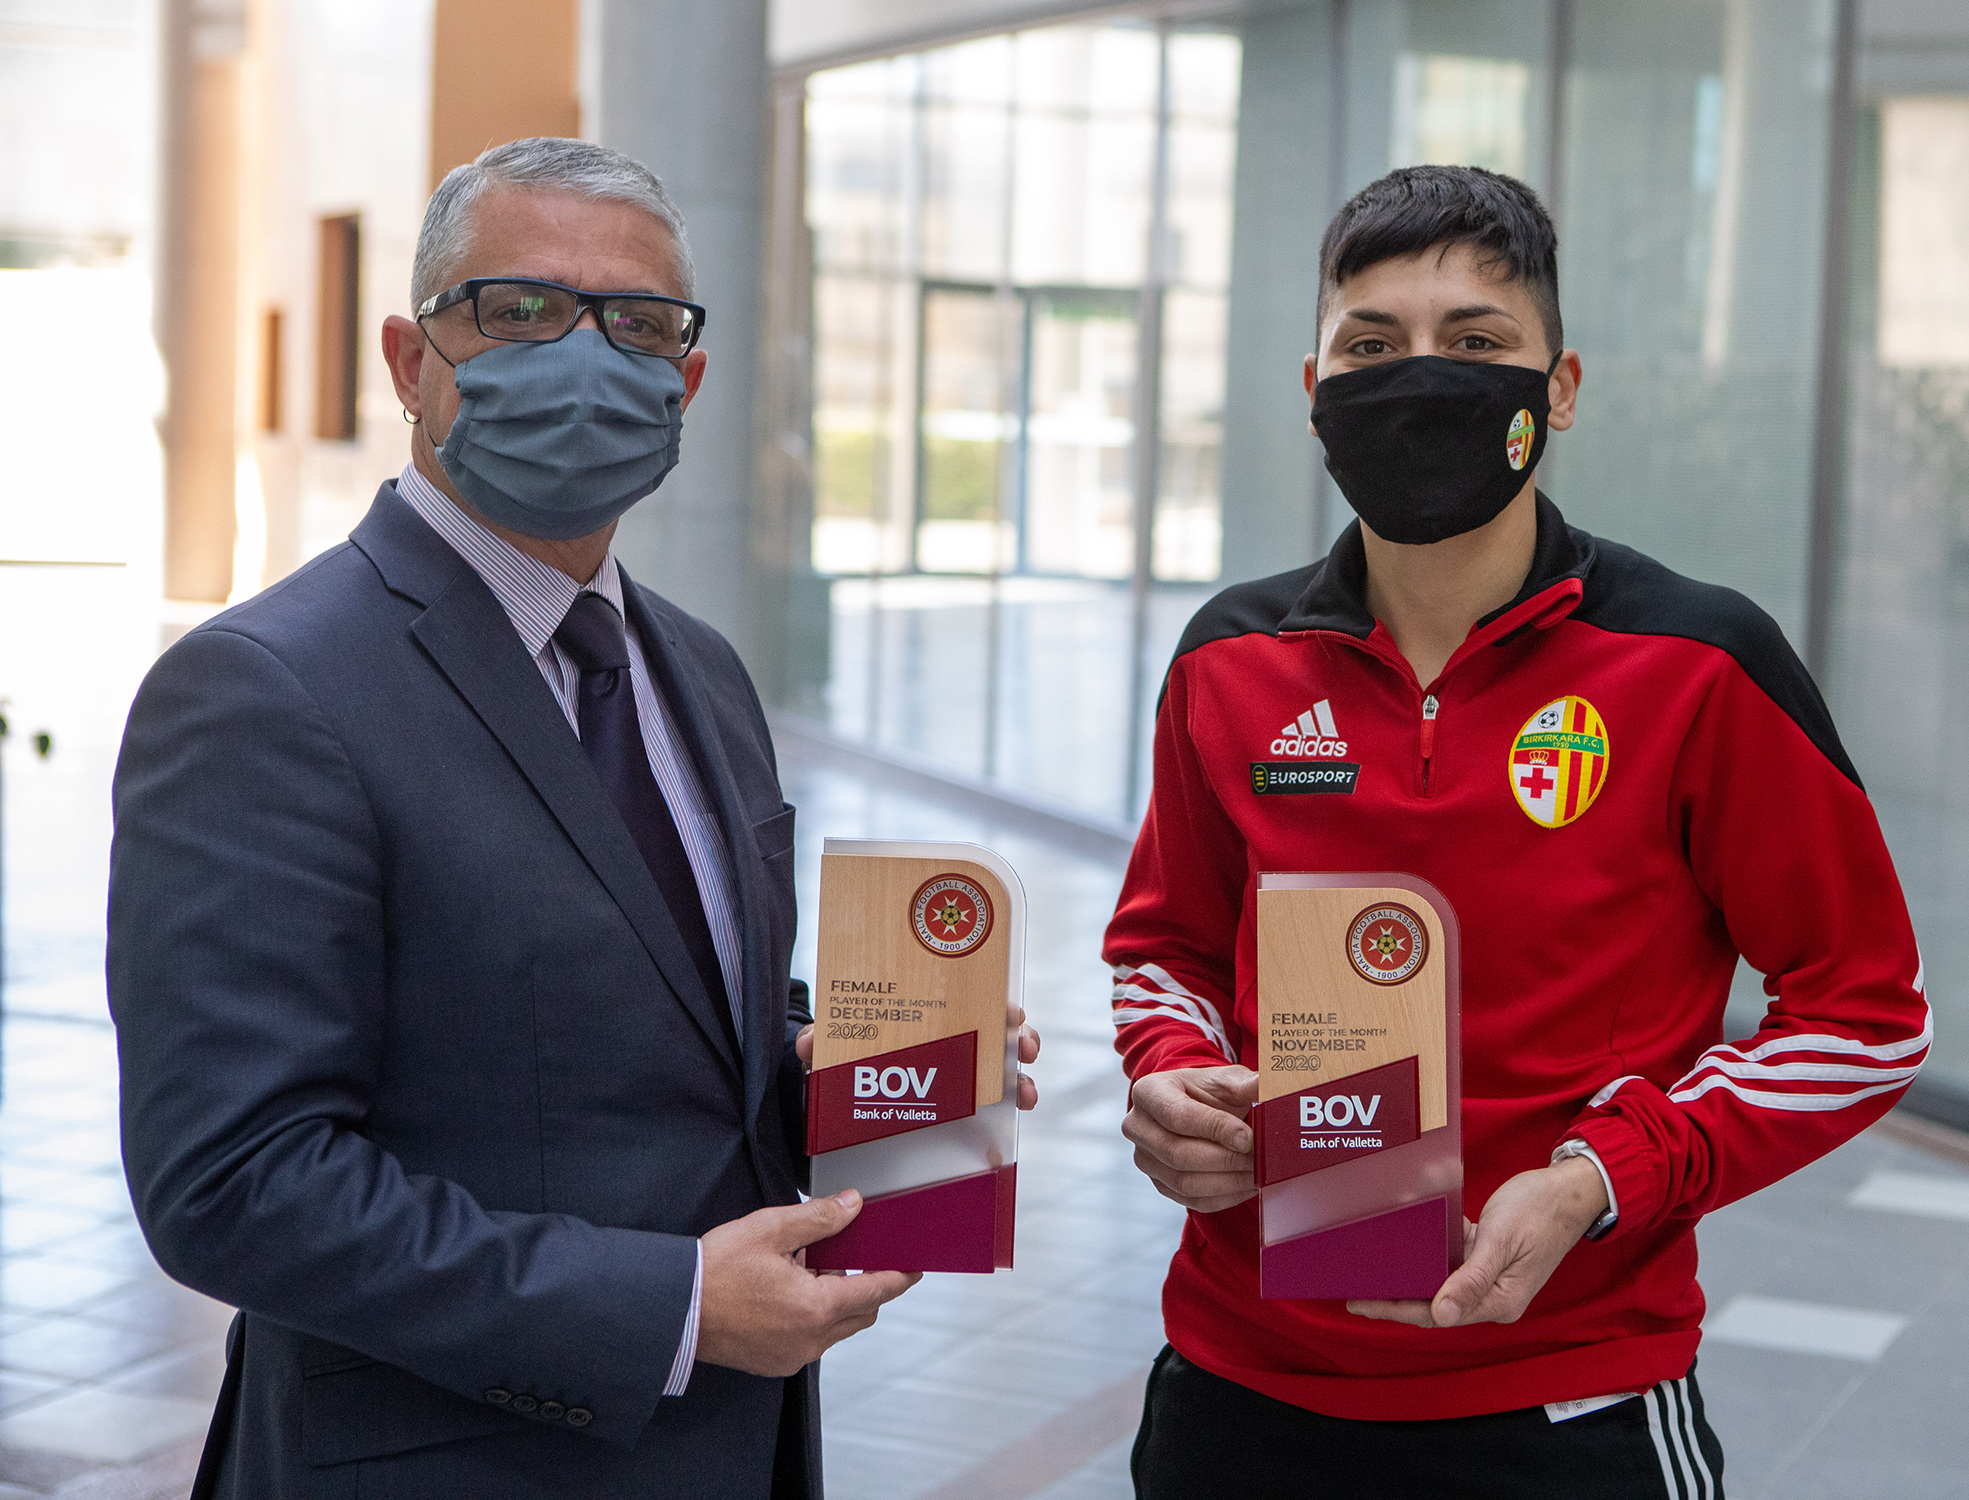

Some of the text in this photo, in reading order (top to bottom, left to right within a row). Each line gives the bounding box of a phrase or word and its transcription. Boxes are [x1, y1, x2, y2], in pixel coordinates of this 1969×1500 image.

[1270, 735, 1348, 757] adidas
[1523, 733, 1600, 748] BIRKIRKARA F.C.
[1269, 771, 1355, 785] EUROSPORT
[916, 881, 986, 944] MALTA FOOTBALL ASSOCIATION
[939, 942, 961, 951] 1900
[1352, 910, 1421, 972] MALTA FOOTBALL ASSOCIATION
[1376, 971, 1398, 979] 1900
[830, 979, 898, 994] FEMALE
[829, 996, 947, 1009] PLAYER OF THE MONTH
[829, 1006, 924, 1022] DECEMBER
[1271, 1012, 1338, 1025] FEMALE
[826, 1022, 879, 1040] 2020
[1271, 1028, 1387, 1037] PLAYER OF THE MONTH
[1271, 1038, 1367, 1052] NOVEMBER
[1270, 1054, 1322, 1072] 2020
[854, 1065, 938, 1099] BOV
[853, 1108, 937, 1121] Bank of Valletta
[1299, 1094, 1381, 1128] BOV
[1300, 1136, 1383, 1149] Bank of Valletta
